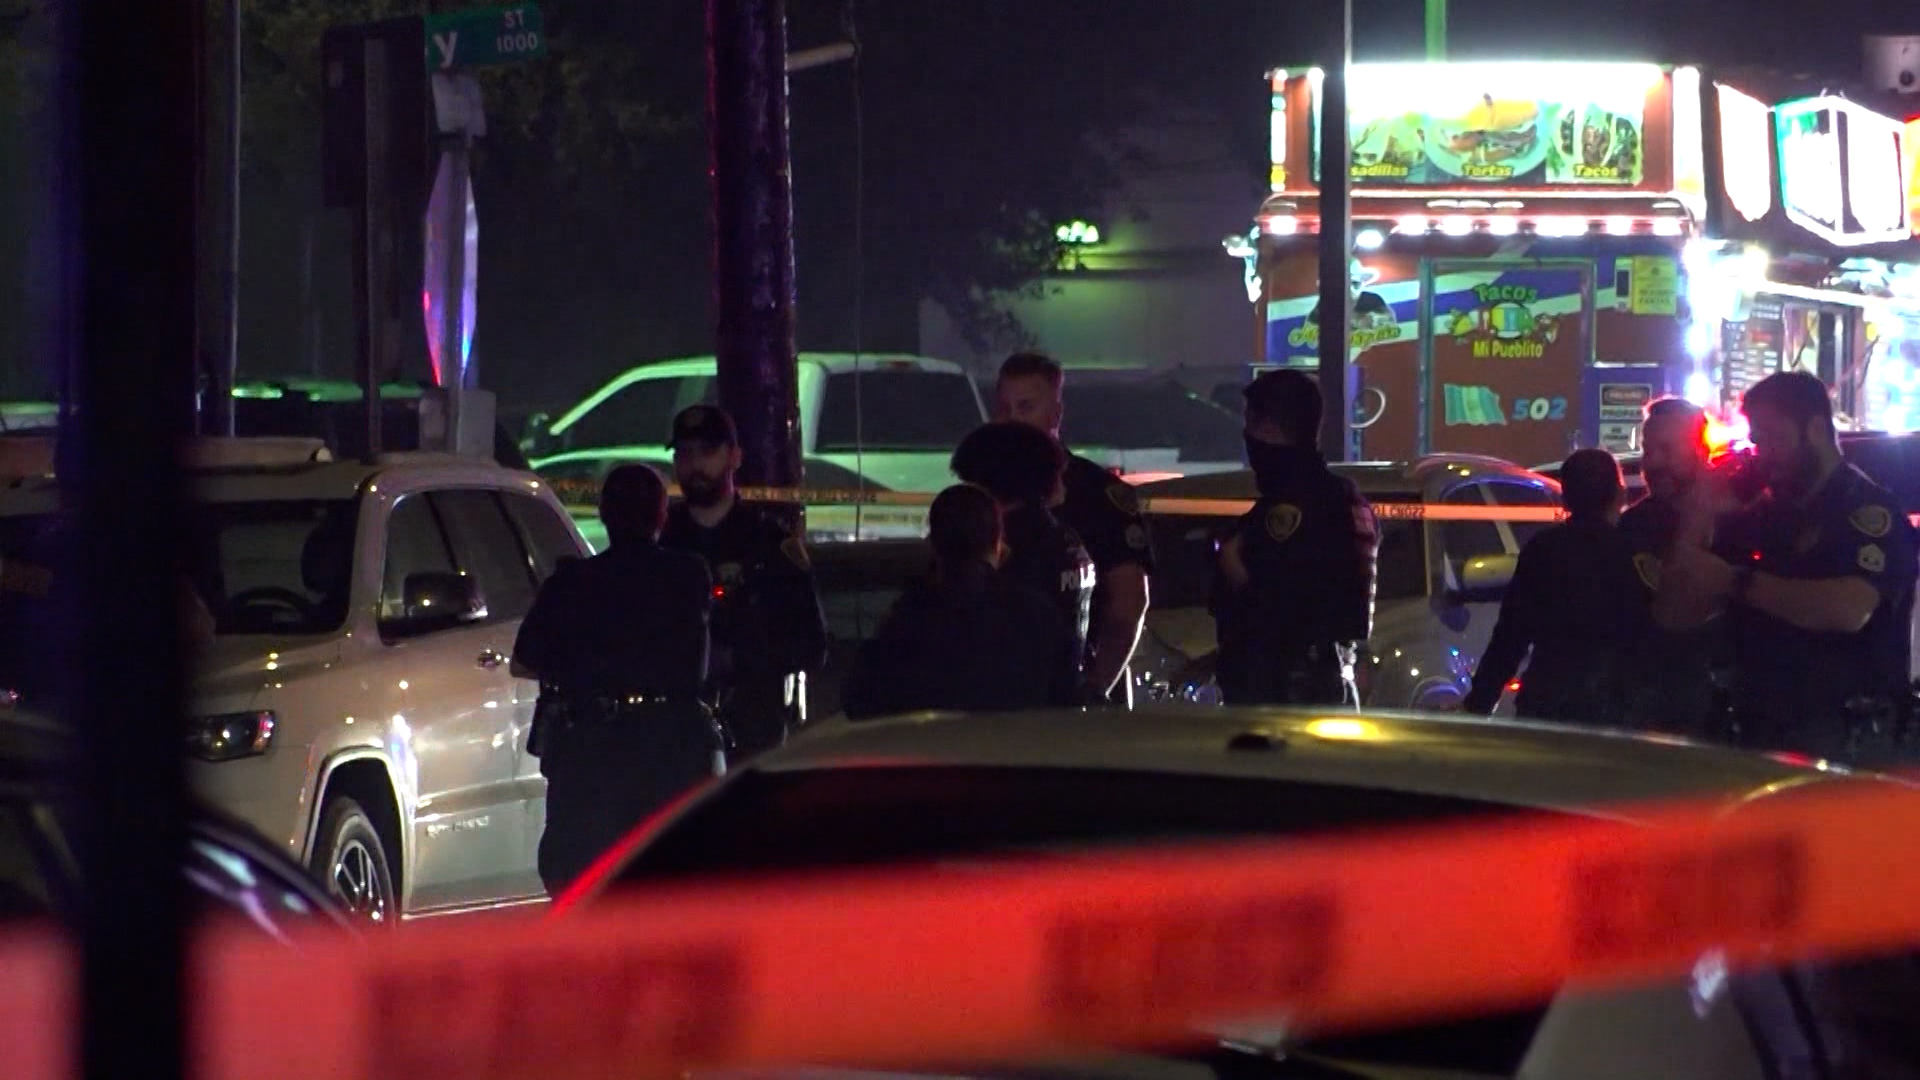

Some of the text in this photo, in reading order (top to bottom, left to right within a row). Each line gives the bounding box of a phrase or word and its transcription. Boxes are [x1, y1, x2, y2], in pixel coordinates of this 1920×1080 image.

[504, 9, 524, 28] ST
[432, 31, 458, 68] y
[496, 31, 538, 52] 1000
[1350, 164, 1409, 177] sadillas
[1462, 164, 1513, 177] Tortas
[1574, 164, 1619, 177] Tacos
[1473, 340, 1544, 358] Mi Pueblito
[1511, 397, 1567, 420] 502
